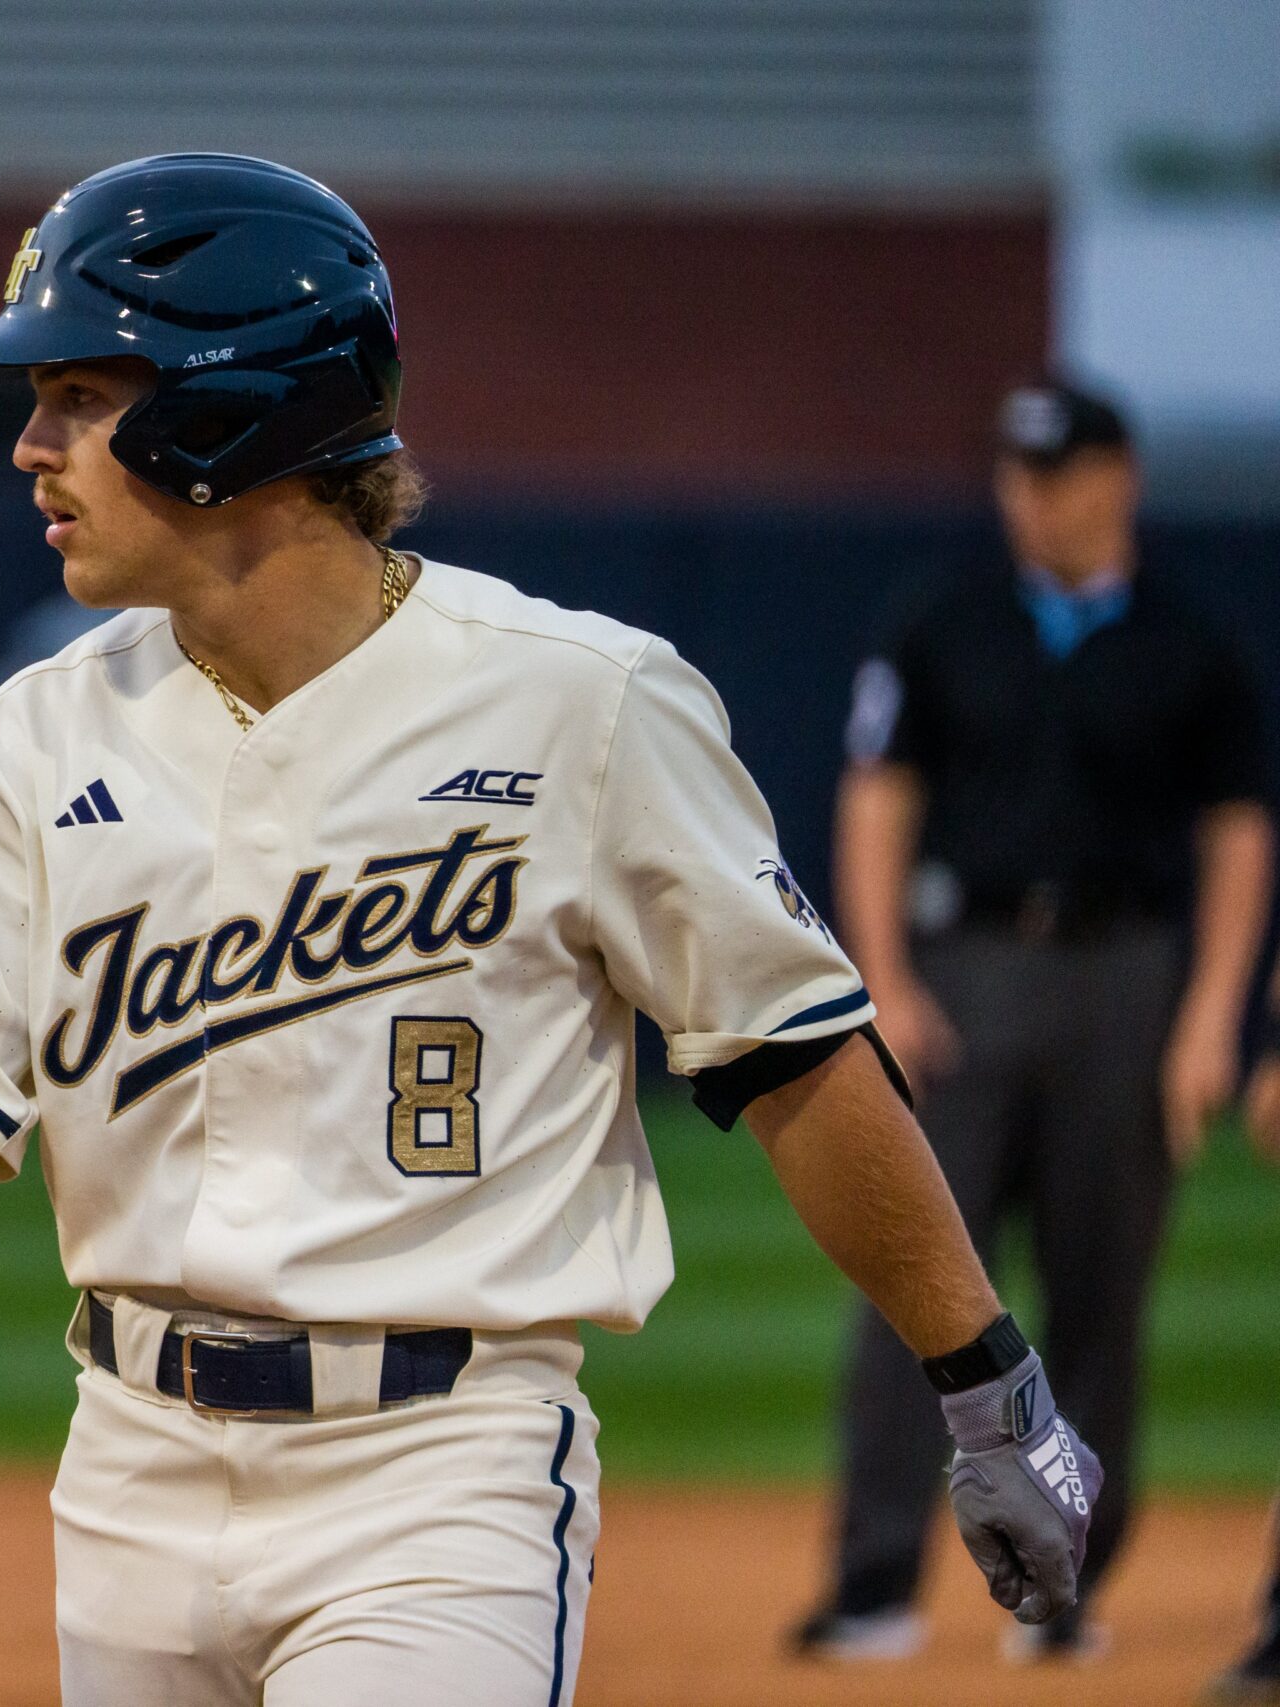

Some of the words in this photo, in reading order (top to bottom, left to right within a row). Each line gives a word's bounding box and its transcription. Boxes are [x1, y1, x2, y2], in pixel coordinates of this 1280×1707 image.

[429, 769, 544, 800] ACC
[40, 824, 530, 1089] Jackets
[387, 1015, 484, 1178] 8
[1054, 1418, 1089, 1515] adidas
